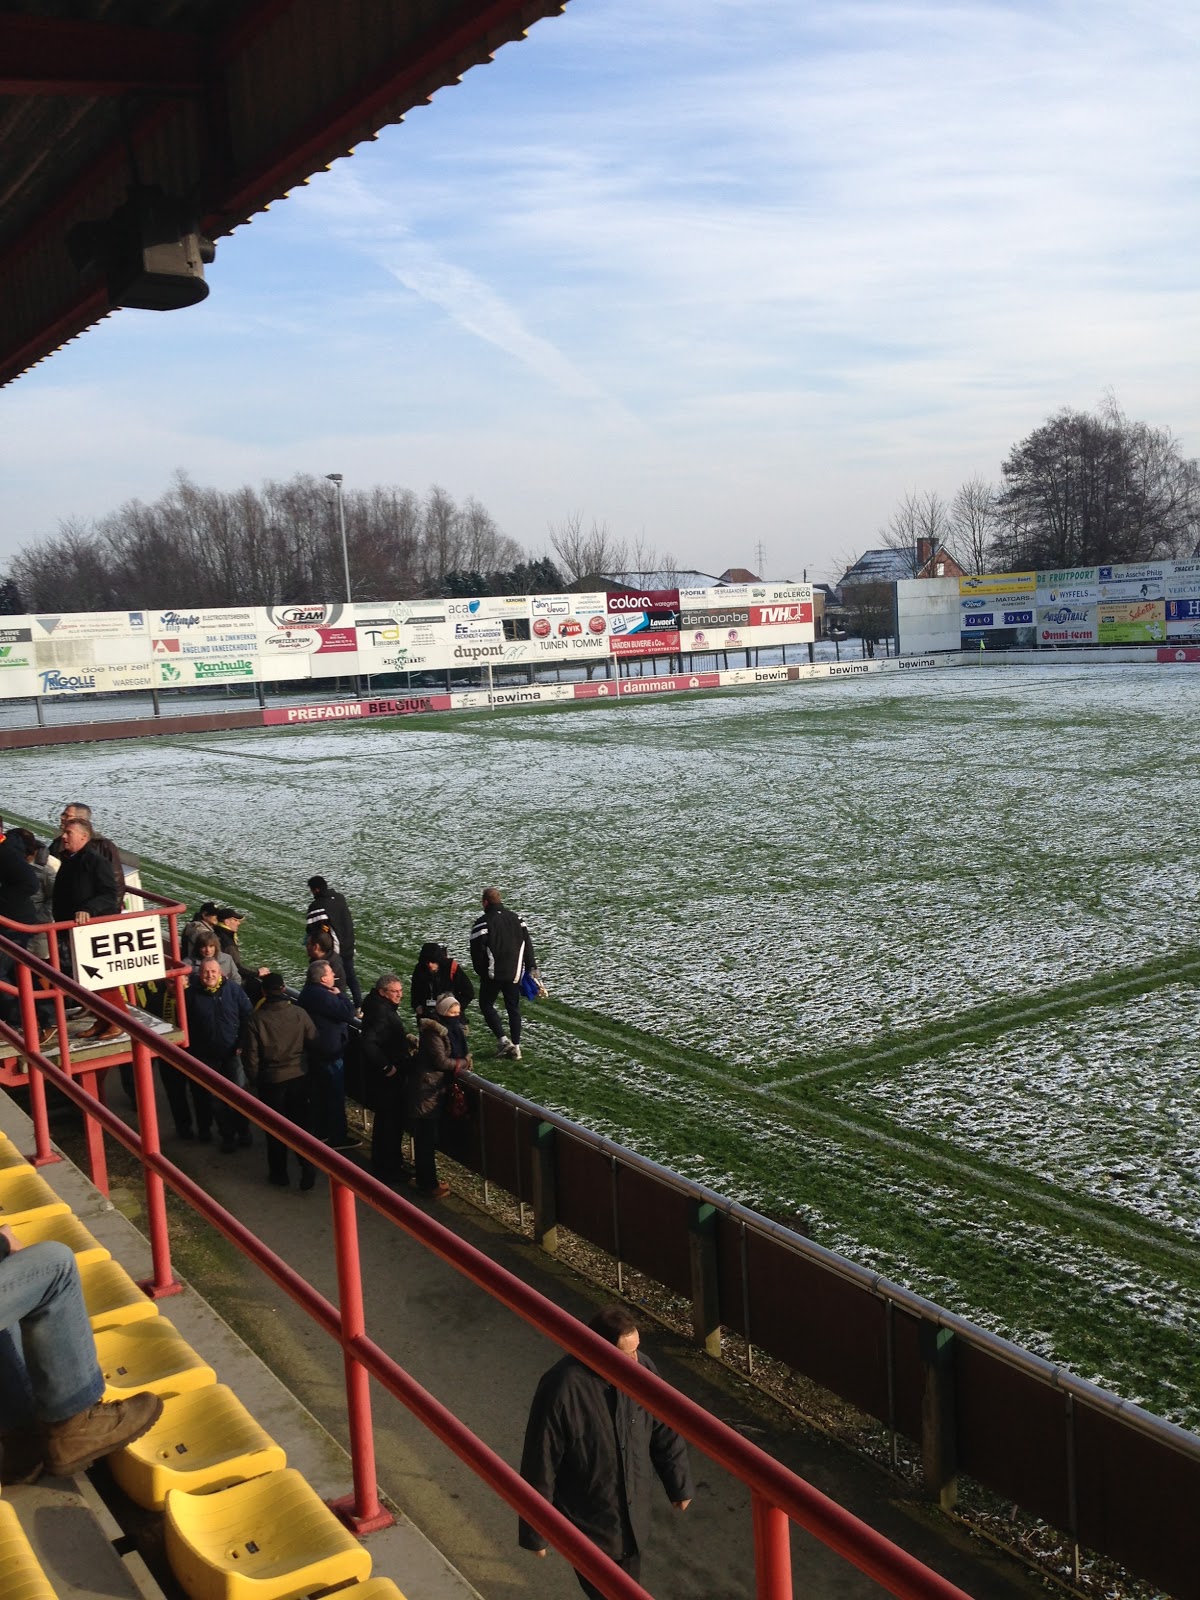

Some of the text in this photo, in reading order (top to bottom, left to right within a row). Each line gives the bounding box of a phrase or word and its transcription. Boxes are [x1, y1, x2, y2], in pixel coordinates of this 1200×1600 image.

[774, 591, 811, 599] DECLERCQ
[1060, 590, 1088, 598] WYFFELS
[609, 595, 652, 609] colora
[448, 604, 469, 614] aca
[760, 607, 790, 623] TVH
[293, 611, 323, 621] TEAM
[682, 612, 749, 625] demoor.be
[540, 638, 603, 650] TUINEN TOMME
[454, 643, 504, 661] dupont
[81, 666, 105, 674] doe
[130, 663, 150, 671] zelf
[193, 660, 253, 672] Vanhulle
[829, 665, 869, 675] bewima
[898, 658, 935, 670] bewima
[755, 671, 788, 681] bewim
[112, 678, 152, 687] WAREGEM
[623, 680, 676, 693] damman
[487, 691, 541, 704] bewima
[287, 704, 362, 721] PREFADIM
[90, 927, 157, 958] ERE
[106, 954, 160, 973] TRIBUNE
